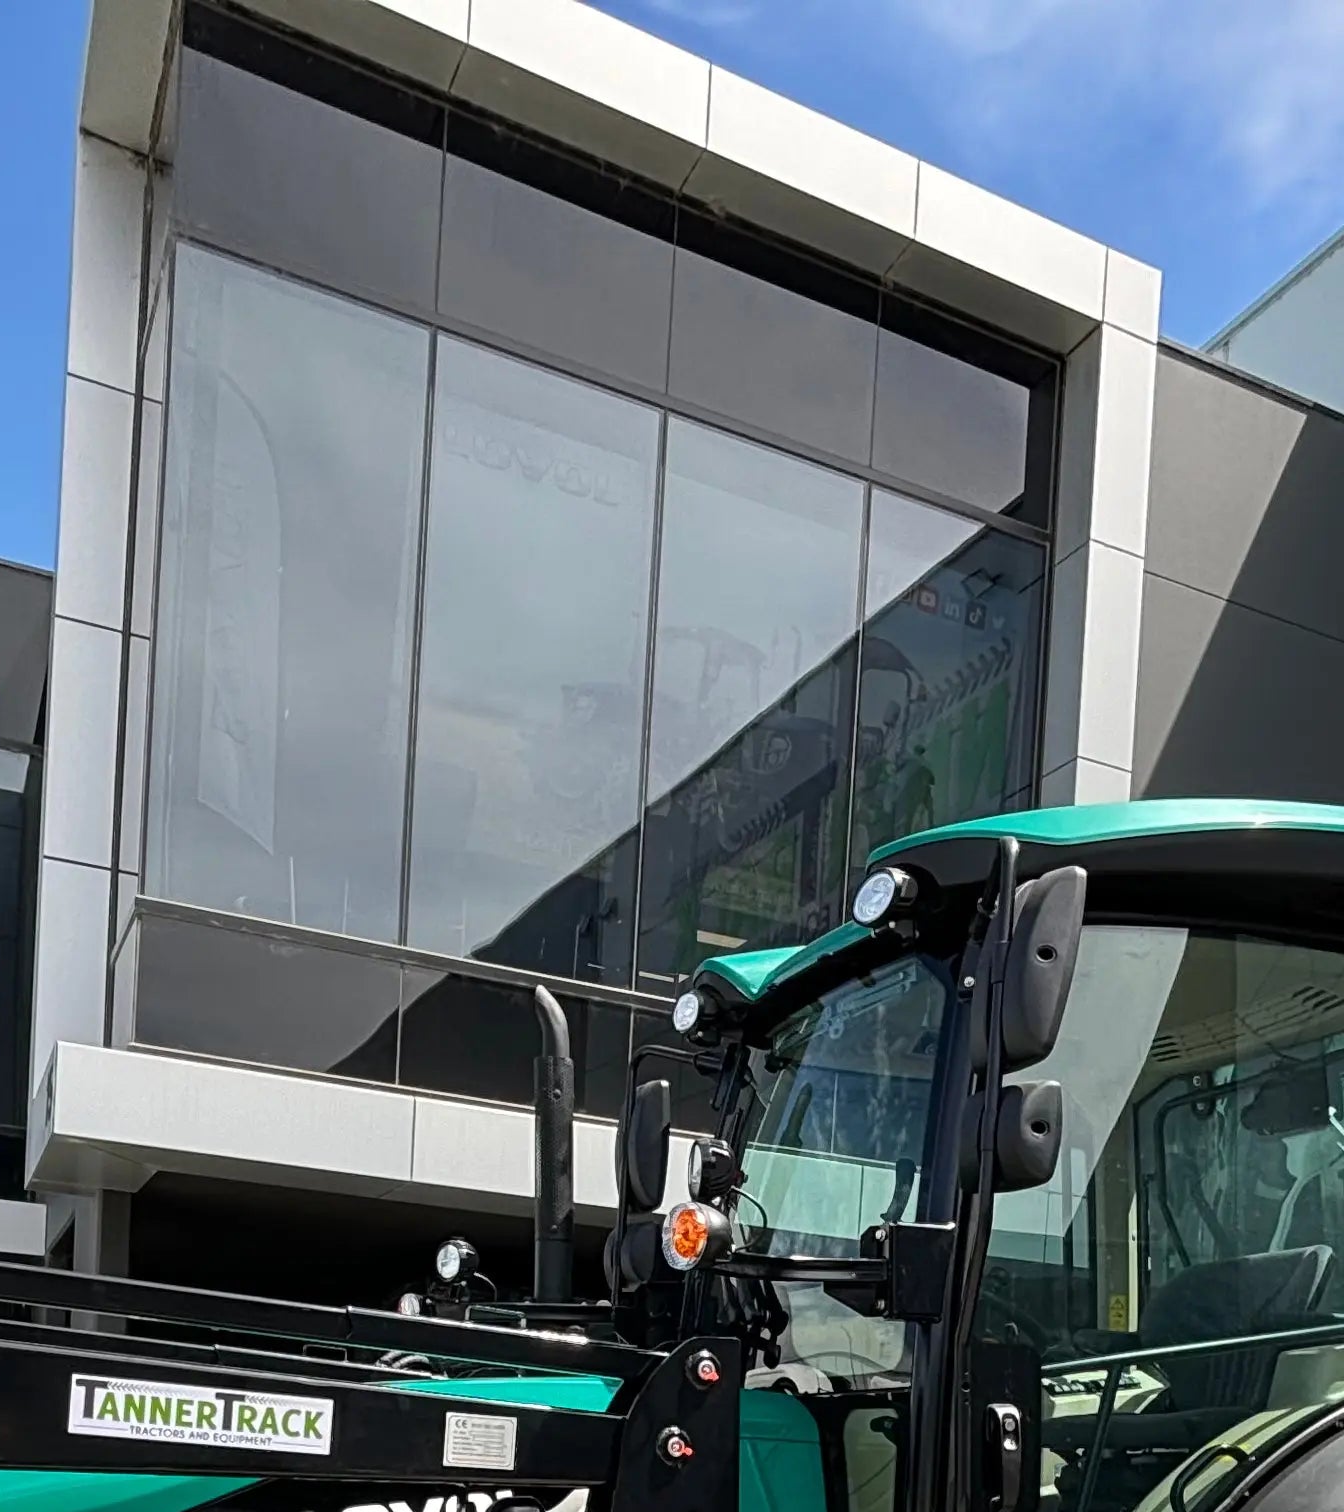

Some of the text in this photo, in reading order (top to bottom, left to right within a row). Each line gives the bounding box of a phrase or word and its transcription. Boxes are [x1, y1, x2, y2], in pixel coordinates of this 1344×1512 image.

[129, 1425, 272, 1447] TRACTORS AND EQUIPMENT
